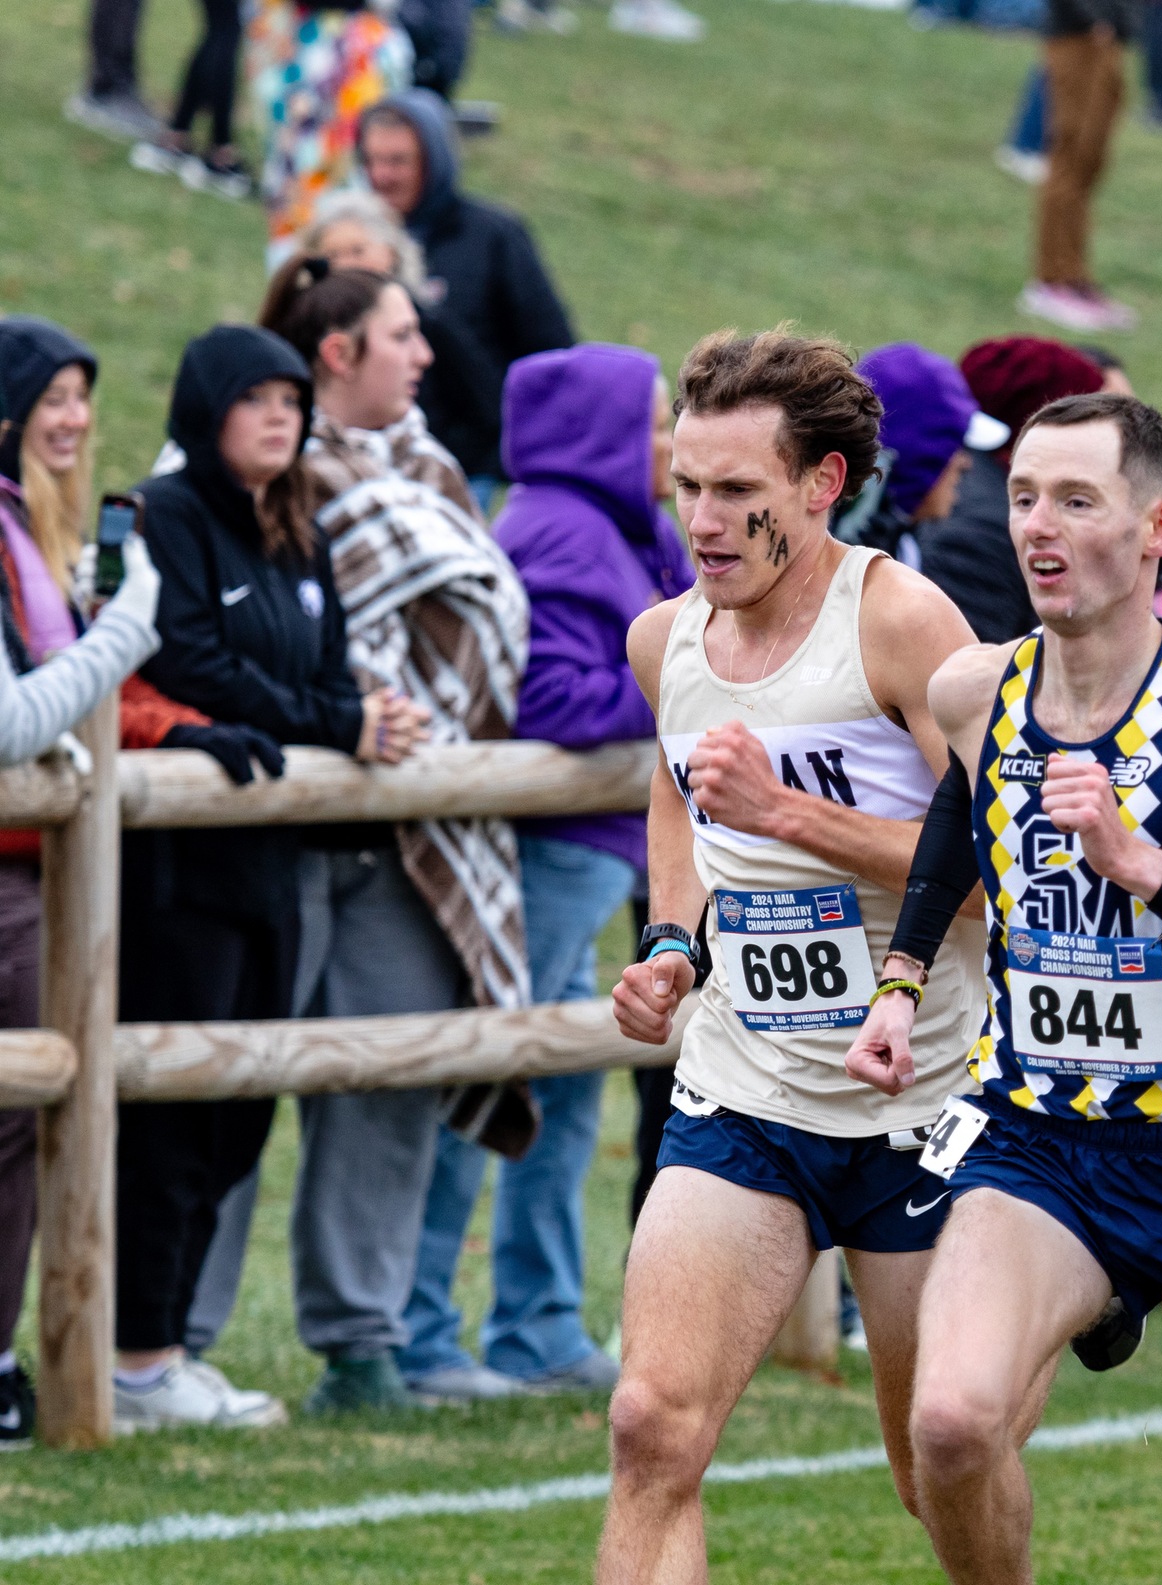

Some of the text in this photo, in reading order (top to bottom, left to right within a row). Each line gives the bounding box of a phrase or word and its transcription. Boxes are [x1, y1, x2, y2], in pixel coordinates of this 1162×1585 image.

[1000, 758, 1044, 777] KCAC
[751, 894, 773, 906] 2024
[774, 893, 796, 905] NAIA
[745, 907, 771, 919] CROSS
[772, 905, 812, 918] COUNTRY
[746, 918, 815, 931] CHAMPIONSHIPS
[1051, 934, 1076, 948] 2024
[1077, 937, 1097, 951] NAIA
[1040, 947, 1070, 961] CROSS
[1072, 951, 1113, 966] COUNTRY
[741, 940, 848, 1003] 698
[1040, 960, 1113, 979] CHAMPIONSHIPS
[746, 1013, 775, 1025] COLUMBIA,
[791, 1013, 828, 1024] NOVEMBER
[829, 1011, 843, 1021] 22,
[844, 1008, 864, 1019] 2024
[1028, 985, 1143, 1050] 844
[1027, 1056, 1062, 1069] COLUMBIA,
[1081, 1062, 1120, 1073] NOVEMBER
[1121, 1064, 1133, 1074] 22,
[1134, 1064, 1156, 1074] 2024
[929, 1109, 962, 1158] 4
